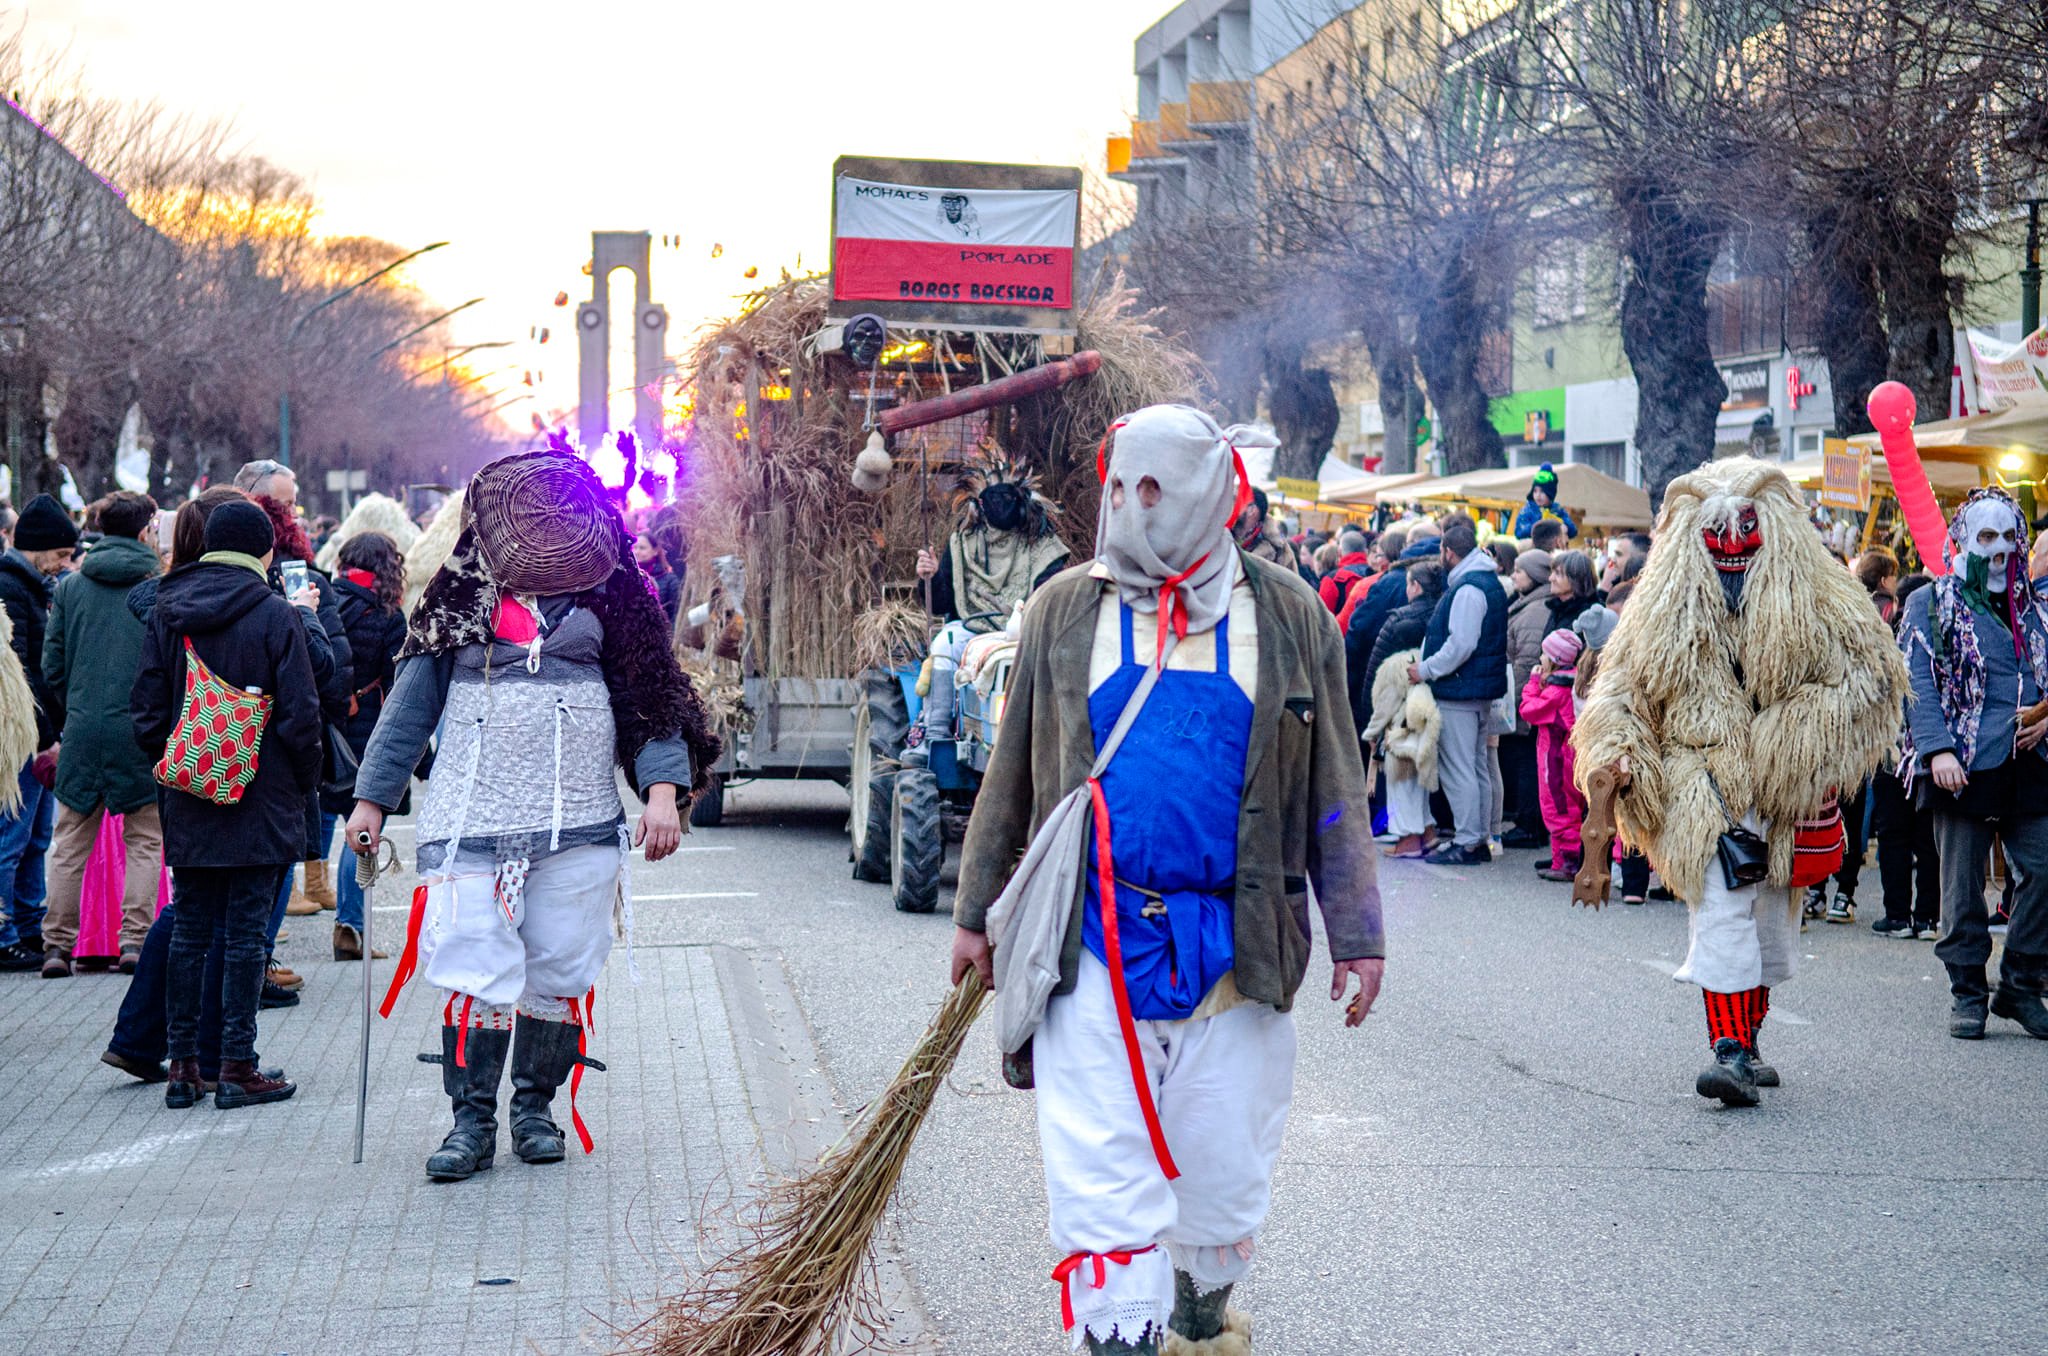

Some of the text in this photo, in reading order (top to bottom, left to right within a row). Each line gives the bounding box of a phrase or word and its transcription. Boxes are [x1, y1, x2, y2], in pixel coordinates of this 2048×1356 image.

[855, 185, 929, 201] MOHACS
[960, 250, 1055, 266] POKLADE
[899, 280, 1055, 303] BOROS BOCSKOR
